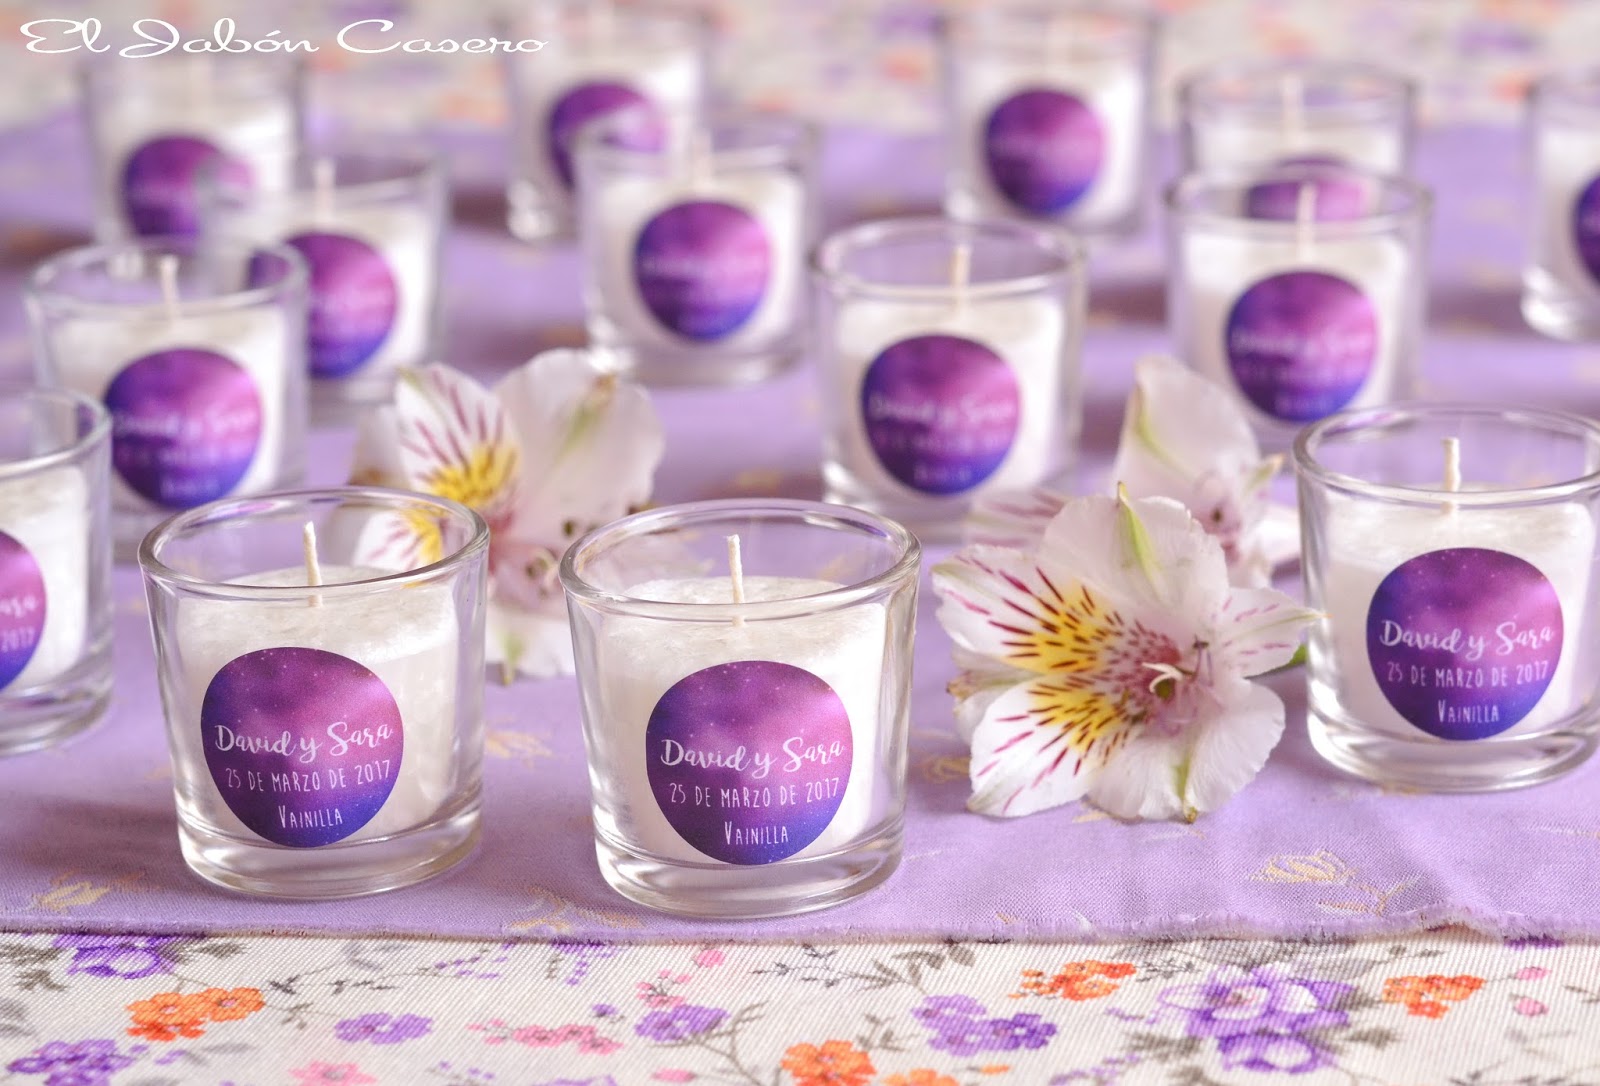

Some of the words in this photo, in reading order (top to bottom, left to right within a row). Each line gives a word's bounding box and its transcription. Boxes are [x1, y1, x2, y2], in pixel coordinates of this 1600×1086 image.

[1379, 620, 1466, 654] David
[1468, 635, 1492, 661] y
[1496, 621, 1555, 656] Sara
[1386, 661, 1404, 683] 25
[1411, 665, 1426, 687] DE
[1435, 666, 1485, 689] MARZO
[1491, 666, 1508, 687] DE
[1516, 660, 1550, 685] 2017
[214, 724, 297, 756] David
[299, 736, 324, 764] y
[326, 721, 394, 757] Sara
[660, 738, 751, 772] David
[751, 752, 778, 780] y
[782, 736, 845, 773] Sara
[225, 767, 242, 790] 25
[247, 770, 265, 792] DE
[271, 771, 321, 793] MARZO
[328, 767, 347, 789] DE
[354, 759, 391, 786] 2017
[669, 782, 686, 804] 25
[695, 785, 712, 808] DE
[720, 787, 771, 808] MARZO
[779, 785, 797, 806] DE
[805, 777, 840, 803] 2017
